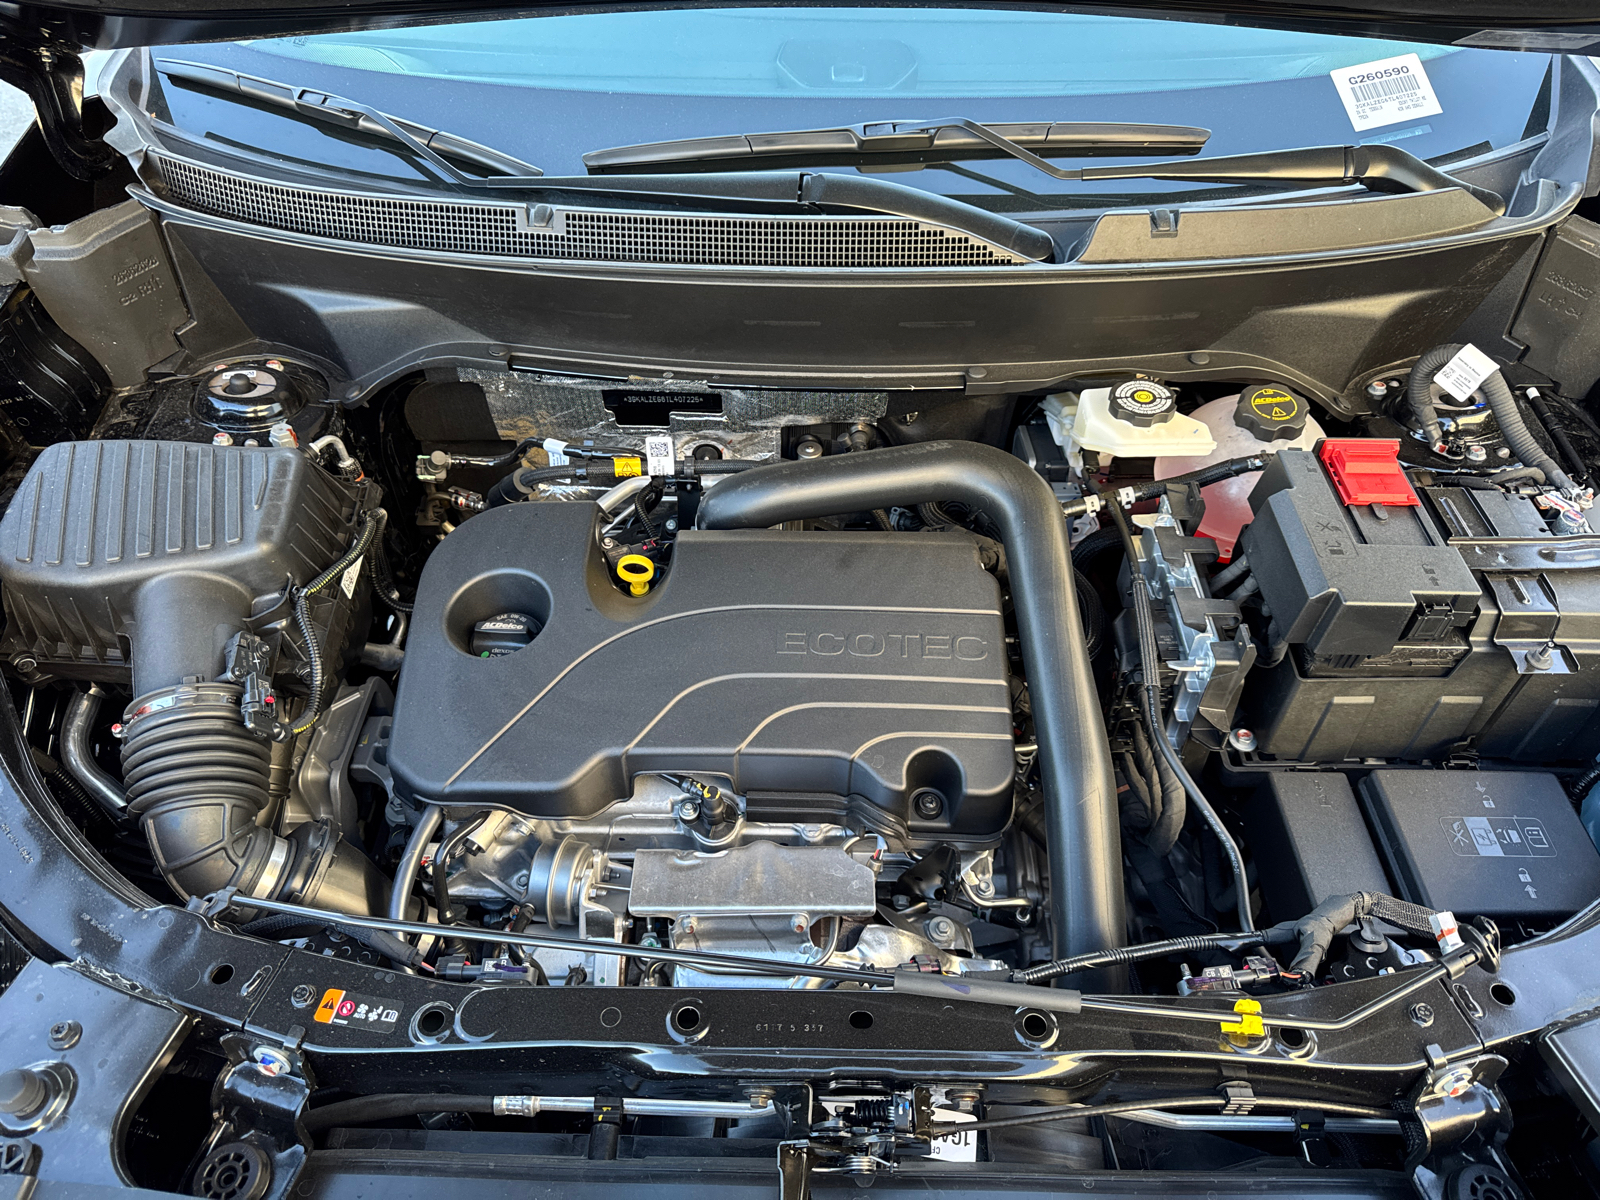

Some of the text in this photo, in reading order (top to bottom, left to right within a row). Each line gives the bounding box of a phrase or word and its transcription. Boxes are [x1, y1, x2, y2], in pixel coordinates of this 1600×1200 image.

[1348, 65, 1410, 85] G260590
[1253, 396, 1291, 405] ACDelco
[510, 613, 527, 623] 0W-20
[480, 622, 524, 630] ACDelco
[776, 632, 989, 662] ECOTEC
